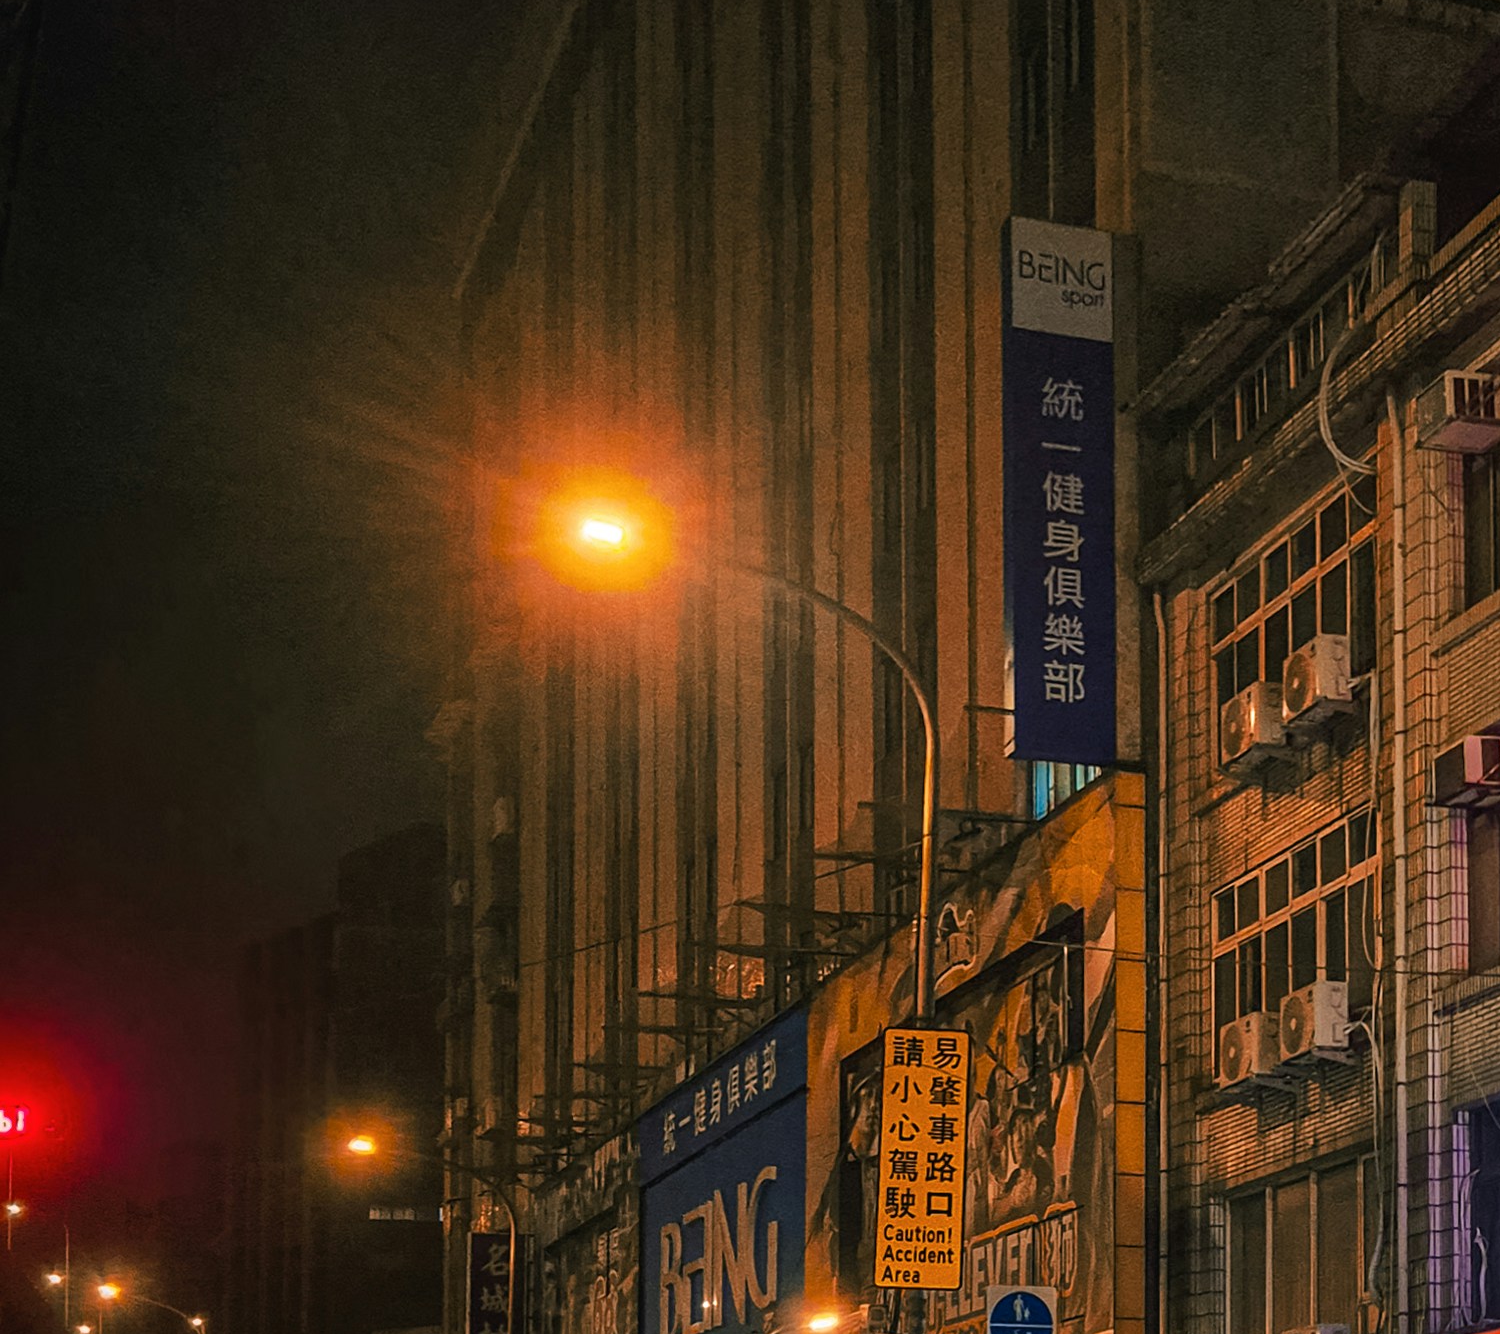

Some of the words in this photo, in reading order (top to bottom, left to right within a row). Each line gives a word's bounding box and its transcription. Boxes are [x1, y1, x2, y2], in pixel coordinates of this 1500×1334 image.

[1018, 249, 1106, 292] BEING
[1040, 373, 1087, 705] 統一健身俱樂部
[660, 1037, 778, 1155] 統一健身俱樂部
[884, 1035, 925, 1220] 請小心駕駛
[924, 1037, 962, 1218] 易肇事路口
[881, 1264, 921, 1284] Area
[882, 1244, 955, 1265] Accident
[883, 1224, 953, 1244] Caution!
